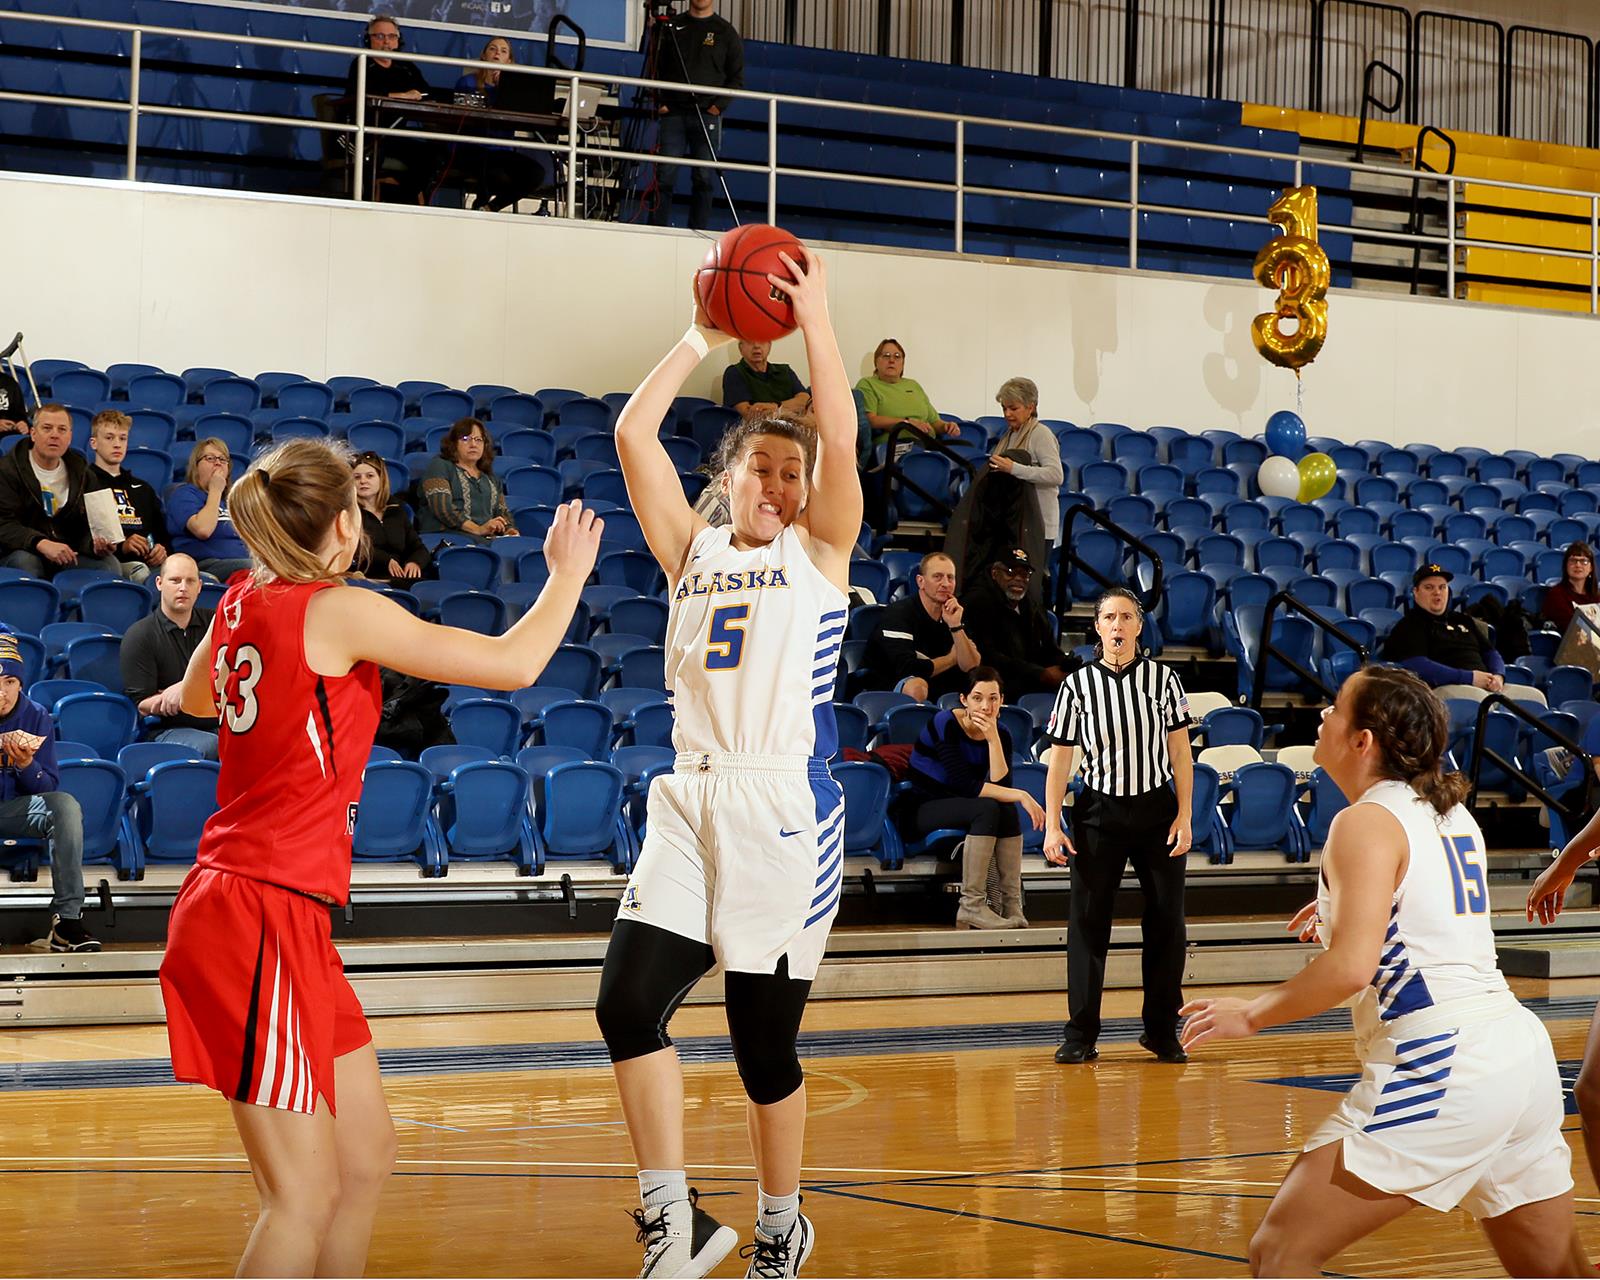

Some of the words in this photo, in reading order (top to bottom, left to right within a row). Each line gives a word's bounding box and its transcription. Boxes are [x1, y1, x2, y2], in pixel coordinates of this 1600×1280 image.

[676, 564, 790, 603] ALASKA
[703, 603, 751, 672] 5
[1440, 833, 1488, 917] 15
